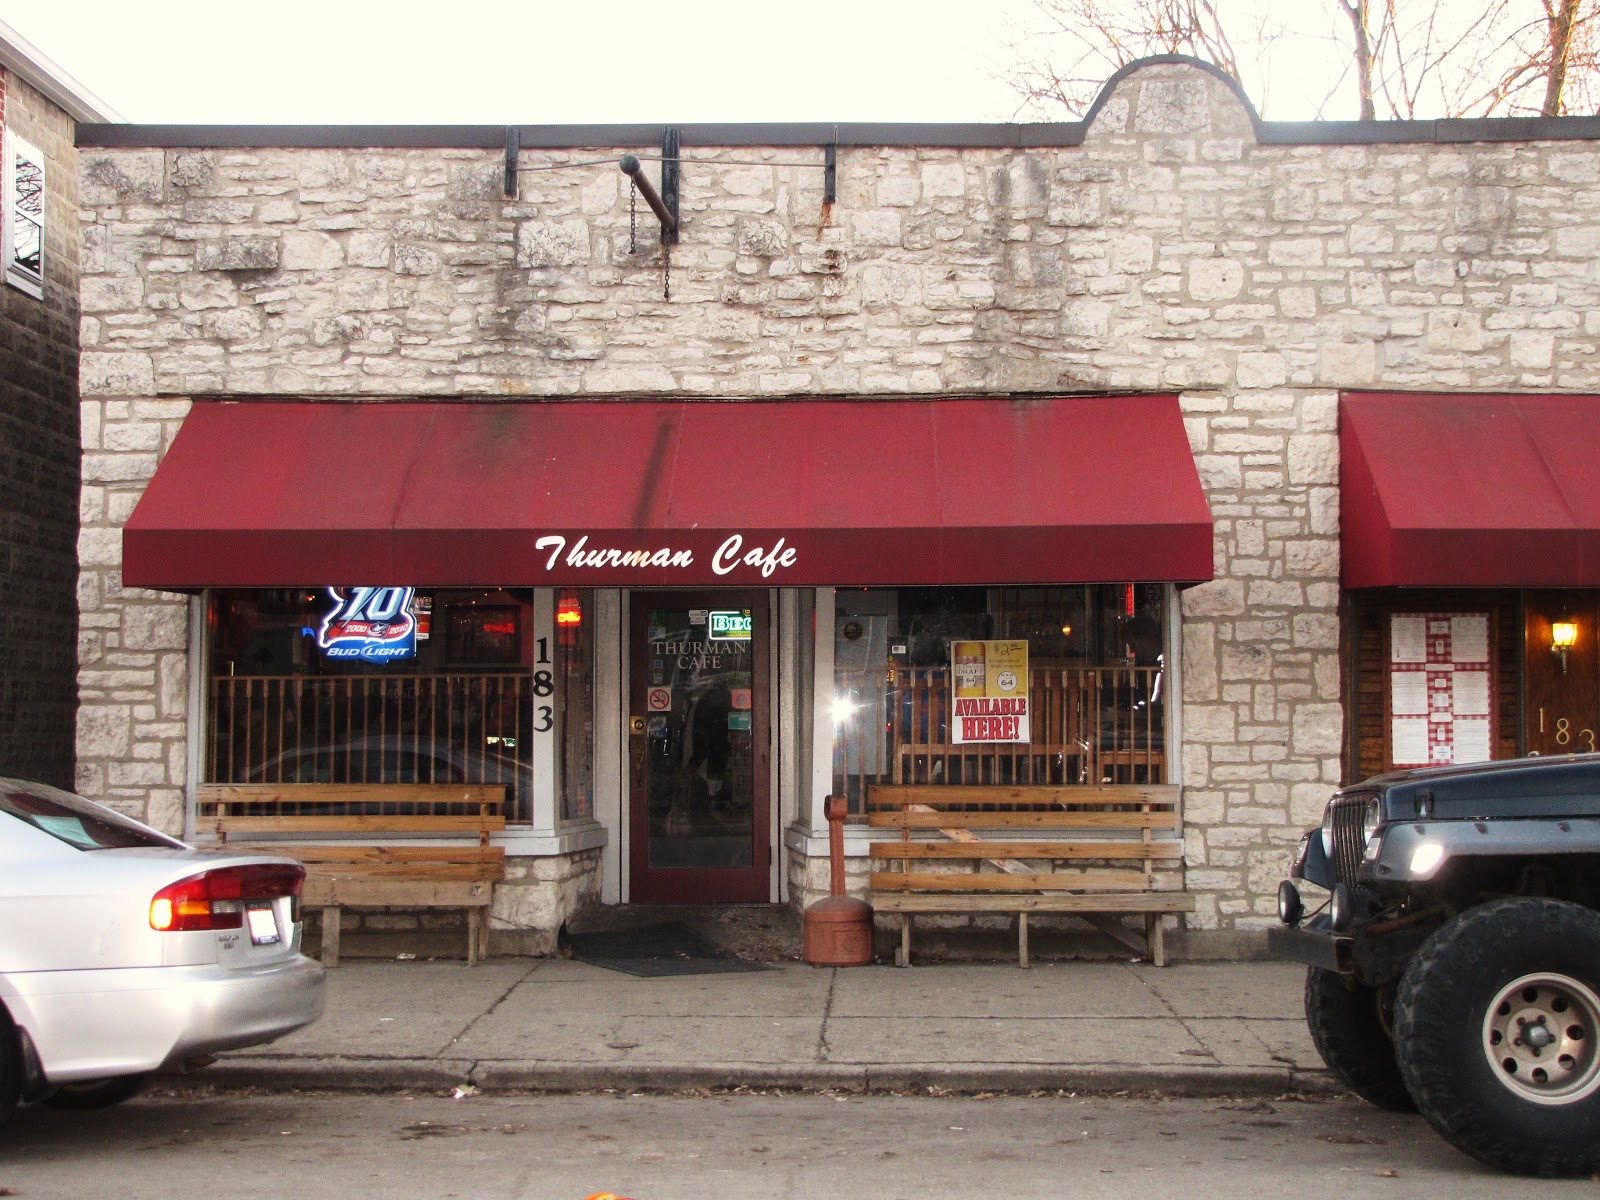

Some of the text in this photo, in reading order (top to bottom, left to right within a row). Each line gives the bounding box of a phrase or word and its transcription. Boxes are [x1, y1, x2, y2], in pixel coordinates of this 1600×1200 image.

[535, 533, 797, 578] Thurman Cafe
[345, 624, 368, 633] 2000
[388, 623, 410, 635] 2010
[652, 641, 747, 655] THURMAN
[677, 655, 722, 670] CAFE
[533, 637, 554, 732] 183
[955, 698, 1027, 716] AVAILABLE
[962, 716, 1020, 740] HERE!
